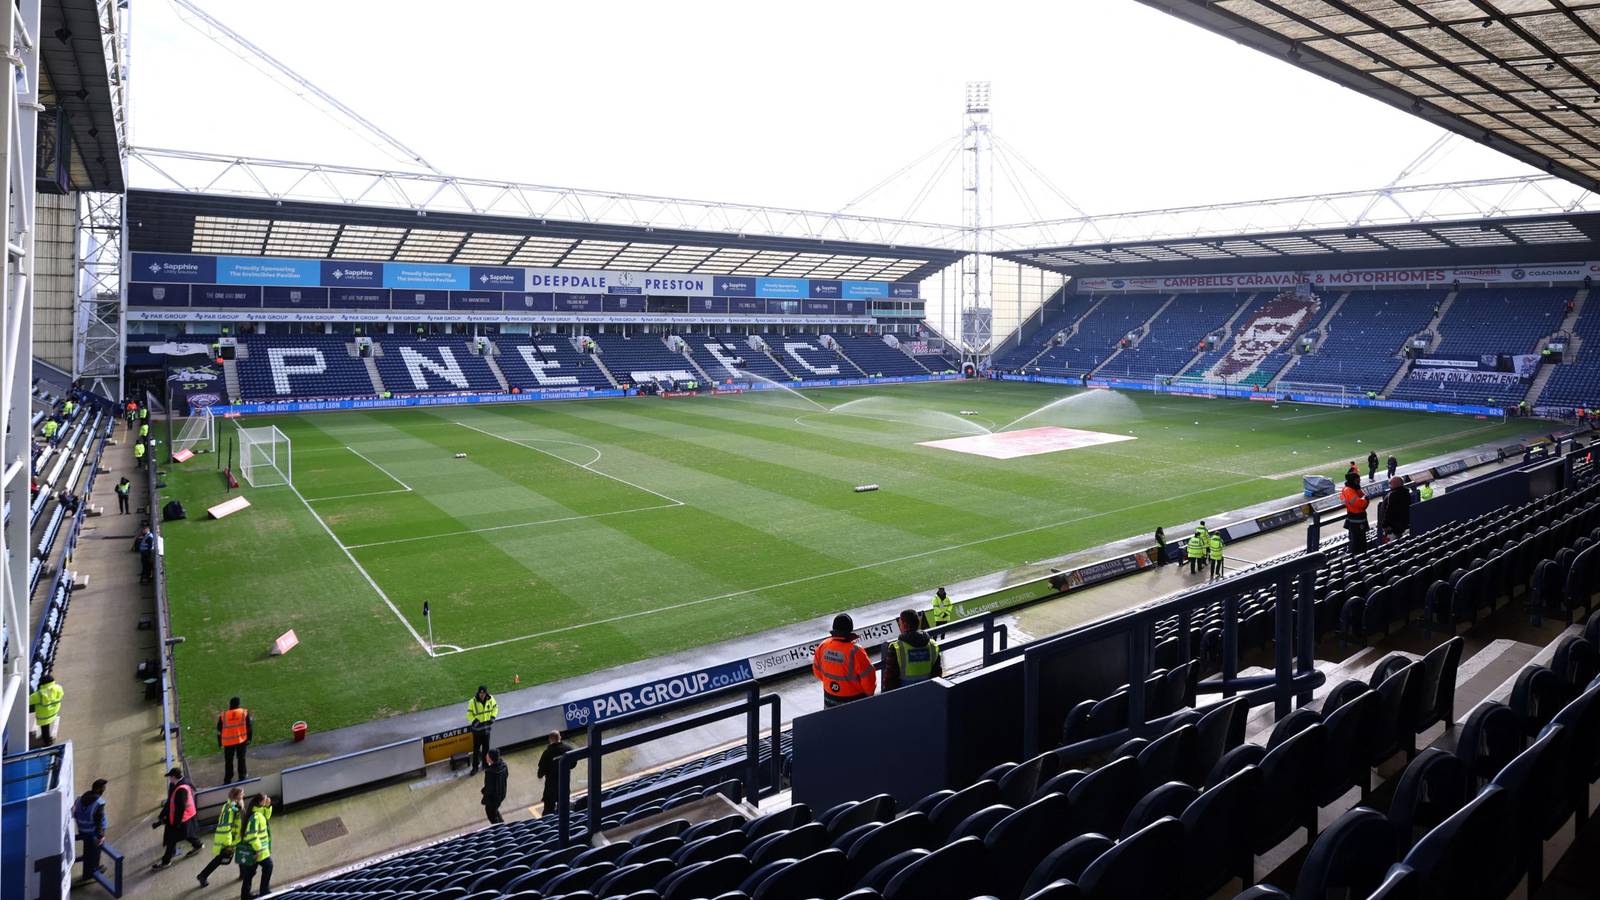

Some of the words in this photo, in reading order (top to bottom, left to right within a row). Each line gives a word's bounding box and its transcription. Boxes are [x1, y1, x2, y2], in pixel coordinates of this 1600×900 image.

[163, 263, 199, 272] Sapphire
[1453, 267, 1501, 277] Campbells
[533, 275, 606, 288] DEEPDALE
[645, 279, 704, 290] PRESTON
[1163, 275, 1234, 287] CAMPBELLS
[1235, 272, 1311, 286] CARAVANS
[1315, 273, 1326, 284] &
[1329, 269, 1446, 283] MOTORHOMES
[1411, 371, 1427, 379] ONE
[1429, 372, 1445, 381] AND
[1448, 373, 1468, 382] ONLY
[1470, 374, 1500, 384] NORTH
[1501, 375, 1519, 385] END
[276, 403, 289, 411] JULY
[353, 400, 373, 408] ALANIS
[963, 601, 999, 617] LANCASHIRE
[593, 665, 751, 719] PAR-GROUP.co.uk
[443, 730, 461, 738] GATE
